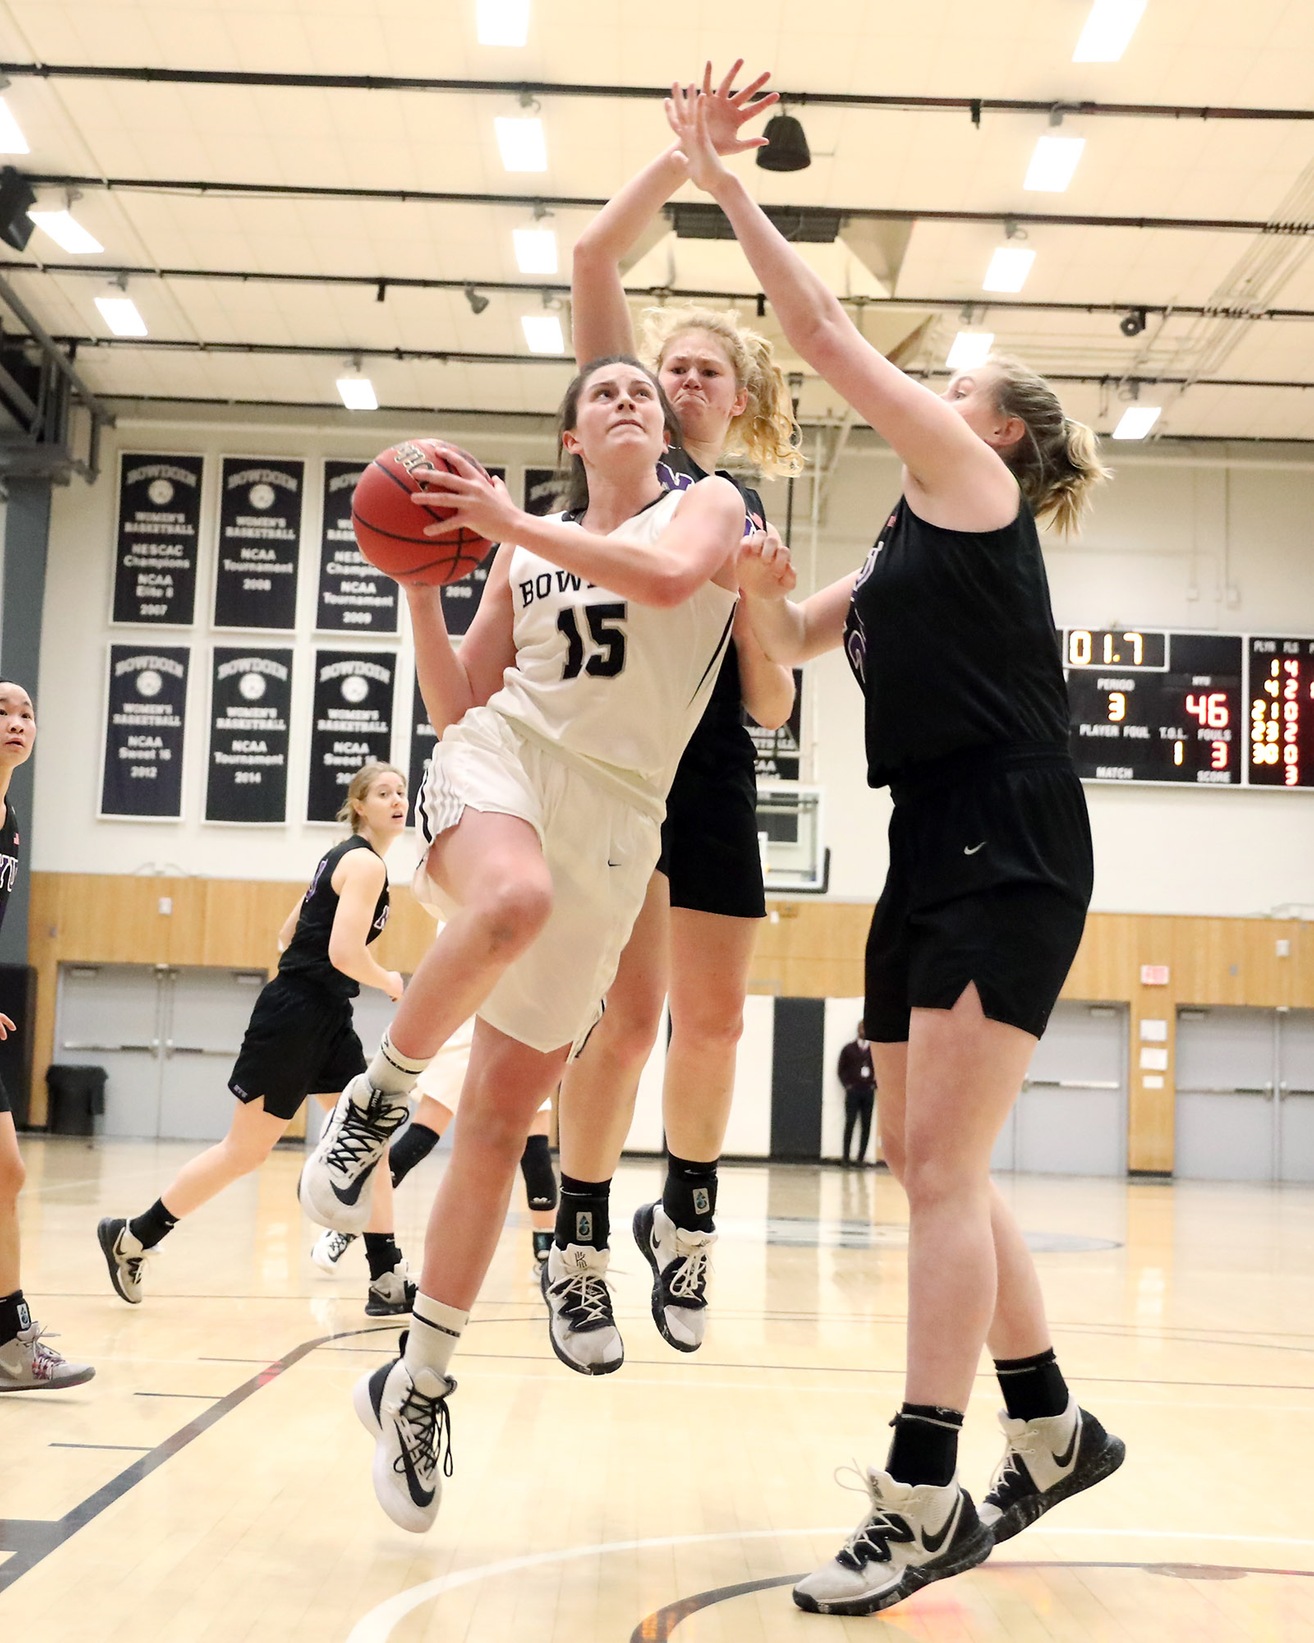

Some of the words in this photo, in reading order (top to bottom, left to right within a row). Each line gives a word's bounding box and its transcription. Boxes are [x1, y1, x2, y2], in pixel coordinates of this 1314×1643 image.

[126, 464, 197, 488] BOWDOIN
[227, 468, 298, 492] BOWDOIN
[124, 522, 195, 535] BASKETBALL
[225, 526, 296, 540] BASKETBALL
[132, 543, 184, 556] NESCAC
[240, 548, 276, 561] NCAA
[123, 555, 190, 569] Champions
[223, 559, 294, 574] Tournament
[137, 573, 174, 586] NCAA
[136, 585, 164, 598] Elite
[165, 586, 174, 598] 8
[341, 581, 377, 594] NCAA
[323, 591, 394, 607] Tournament
[557, 601, 628, 680] 15
[1069, 630, 1143, 665] 01.7
[115, 655, 184, 679] BOWDOIN
[217, 657, 288, 682] BOWDOIN
[320, 661, 391, 685] BOWDOIN
[1270, 658, 1280, 677] 1
[1283, 659, 1299, 677] 4
[1097, 678, 1135, 691] PERIOD
[1264, 679, 1280, 697] 4
[1283, 678, 1299, 699] 2
[1108, 692, 1126, 721] 3
[1185, 693, 1229, 728] 46
[1283, 701, 1299, 721] 0
[113, 713, 181, 727] BASKETBALL
[328, 708, 379, 721] WOMEN'S
[216, 717, 287, 731] BASKETBALL
[317, 719, 388, 733] BASKETBALL
[1080, 724, 1119, 737] PLAYER
[1123, 725, 1149, 739] FOUL
[1251, 720, 1280, 742] 23
[1198, 728, 1232, 742] FOULS
[1283, 721, 1299, 743] 2
[128, 735, 163, 748] NCAA
[231, 740, 268, 753] NCAA
[333, 741, 370, 754] NCAA
[214, 751, 284, 765] Tournament
[1173, 740, 1184, 766] 1
[1211, 741, 1228, 769] 3
[1251, 742, 1280, 765] 30
[1283, 743, 1299, 765] 0
[1096, 767, 1133, 779] MATCH
[1197, 770, 1231, 783] SCORE
[1284, 764, 1299, 786] 3
